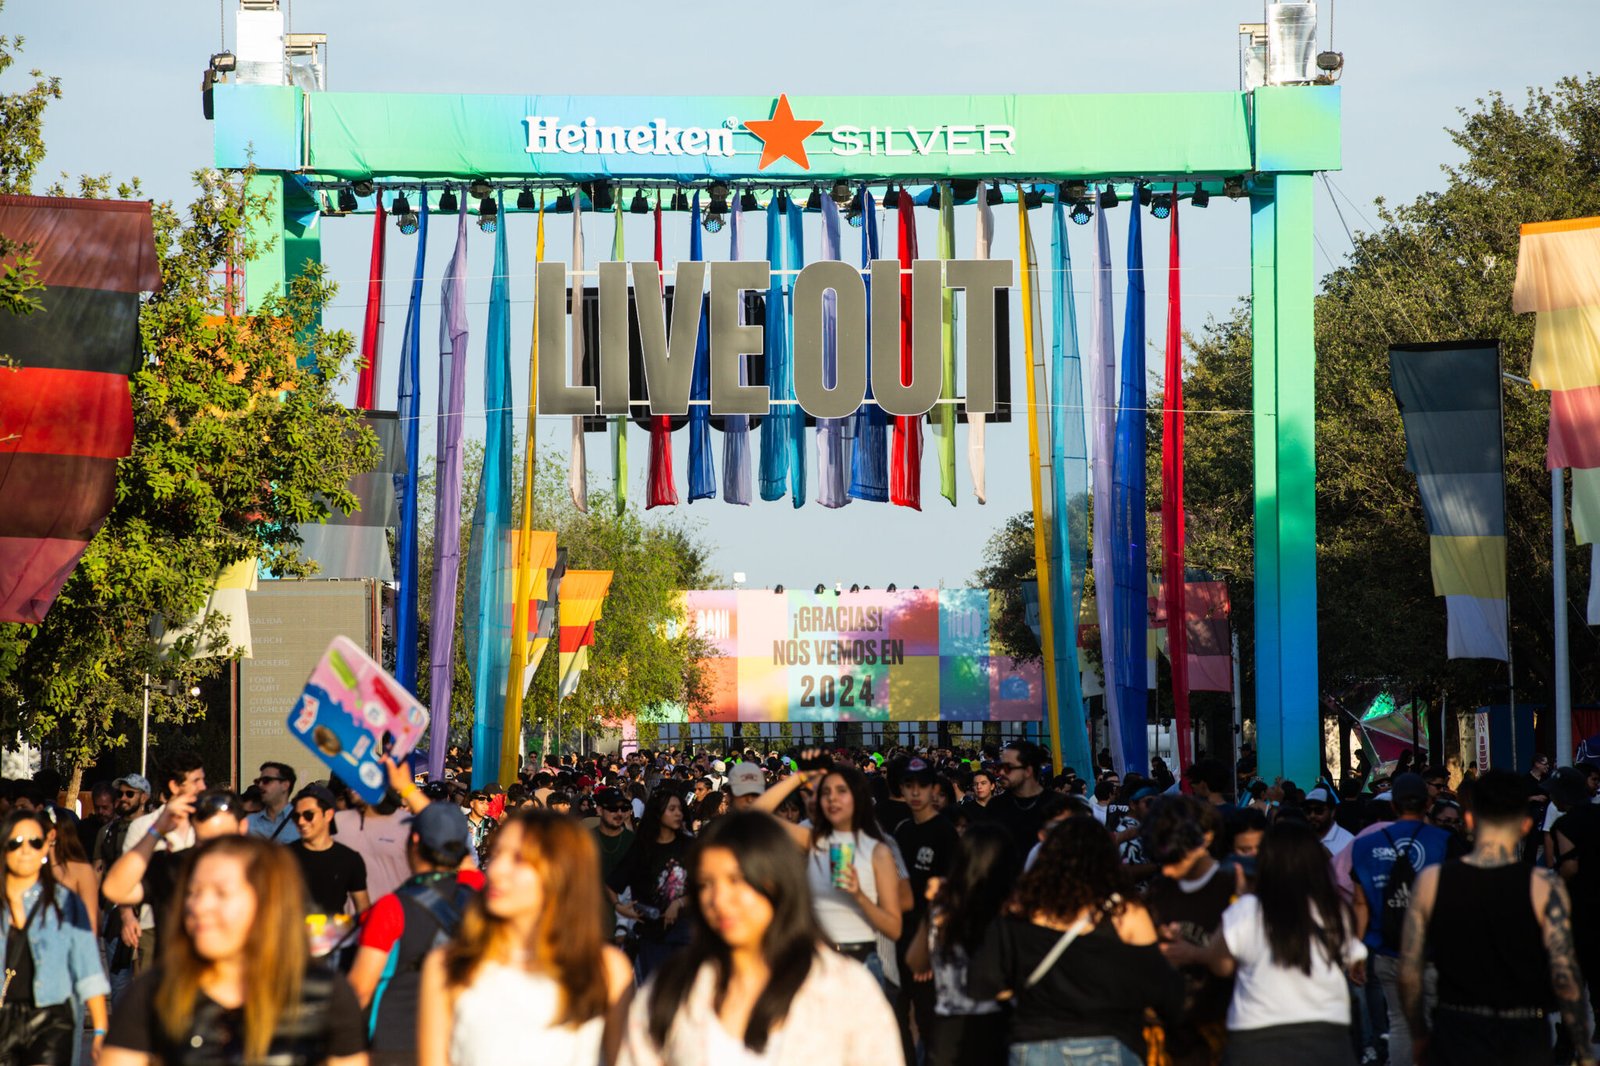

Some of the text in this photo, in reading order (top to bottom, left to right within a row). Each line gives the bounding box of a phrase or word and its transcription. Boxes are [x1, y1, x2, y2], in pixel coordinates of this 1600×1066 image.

[832, 125, 1016, 156] SILVER
[537, 259, 1014, 419] LIVE OUT
[249, 617, 283, 625] SALIDA
[793, 606, 883, 638] ¡GRACIAS!
[773, 640, 904, 665] NOS VEMOS EN
[249, 659, 290, 667] LOCKERS
[249, 676, 275, 684] FOOD
[249, 684, 281, 692] COURT
[800, 674, 875, 708] 2024
[249, 719, 281, 727] SILVER
[249, 727, 284, 735] STUDIO
